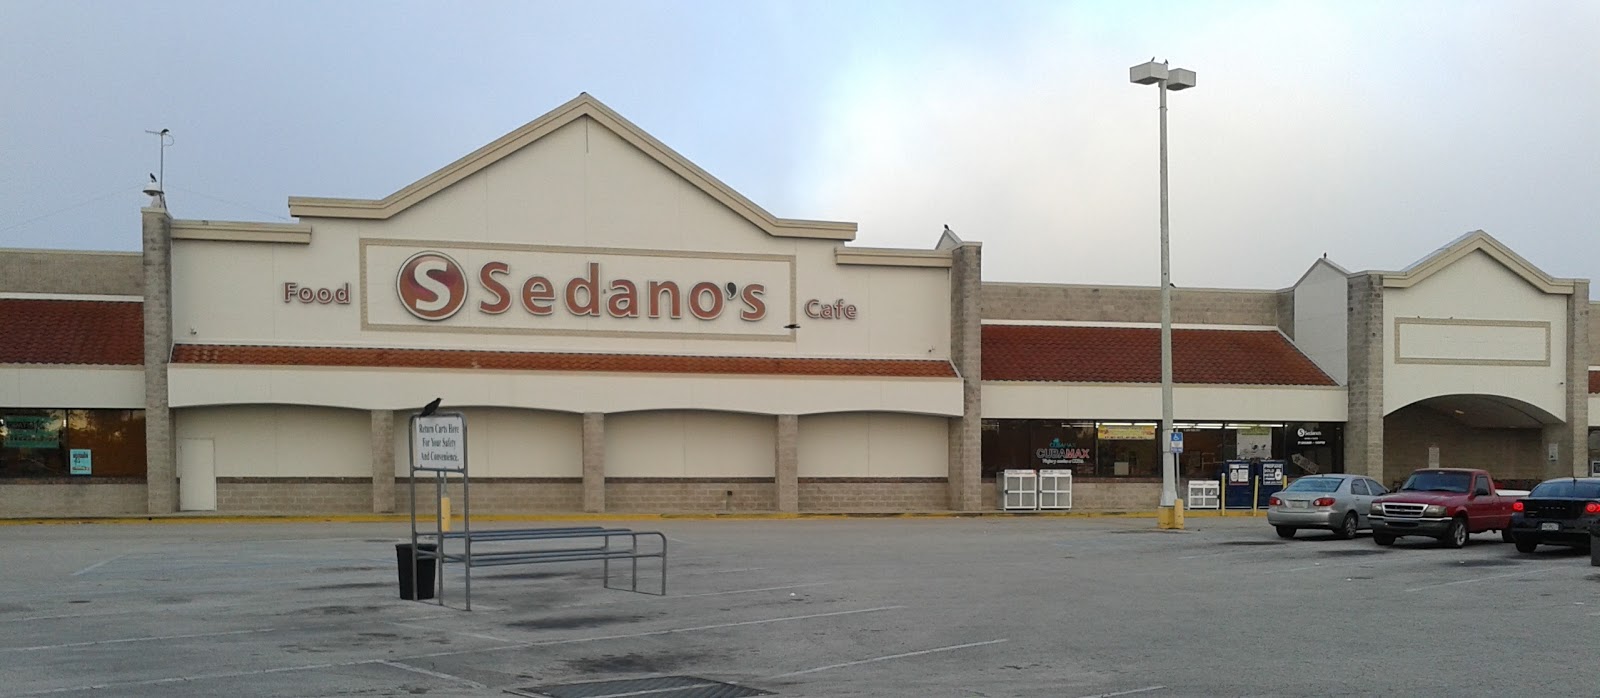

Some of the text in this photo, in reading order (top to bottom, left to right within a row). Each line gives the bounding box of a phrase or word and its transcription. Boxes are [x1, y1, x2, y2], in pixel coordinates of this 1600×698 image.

[283, 282, 351, 304] Food
[479, 261, 767, 321] Sedano's
[804, 298, 857, 320] Cafe
[419, 424, 460, 433] Return Carts Here
[422, 438, 456, 450] For Your Safety
[421, 452, 430, 460] And
[1036, 448, 1090, 459] CUBAMAX
